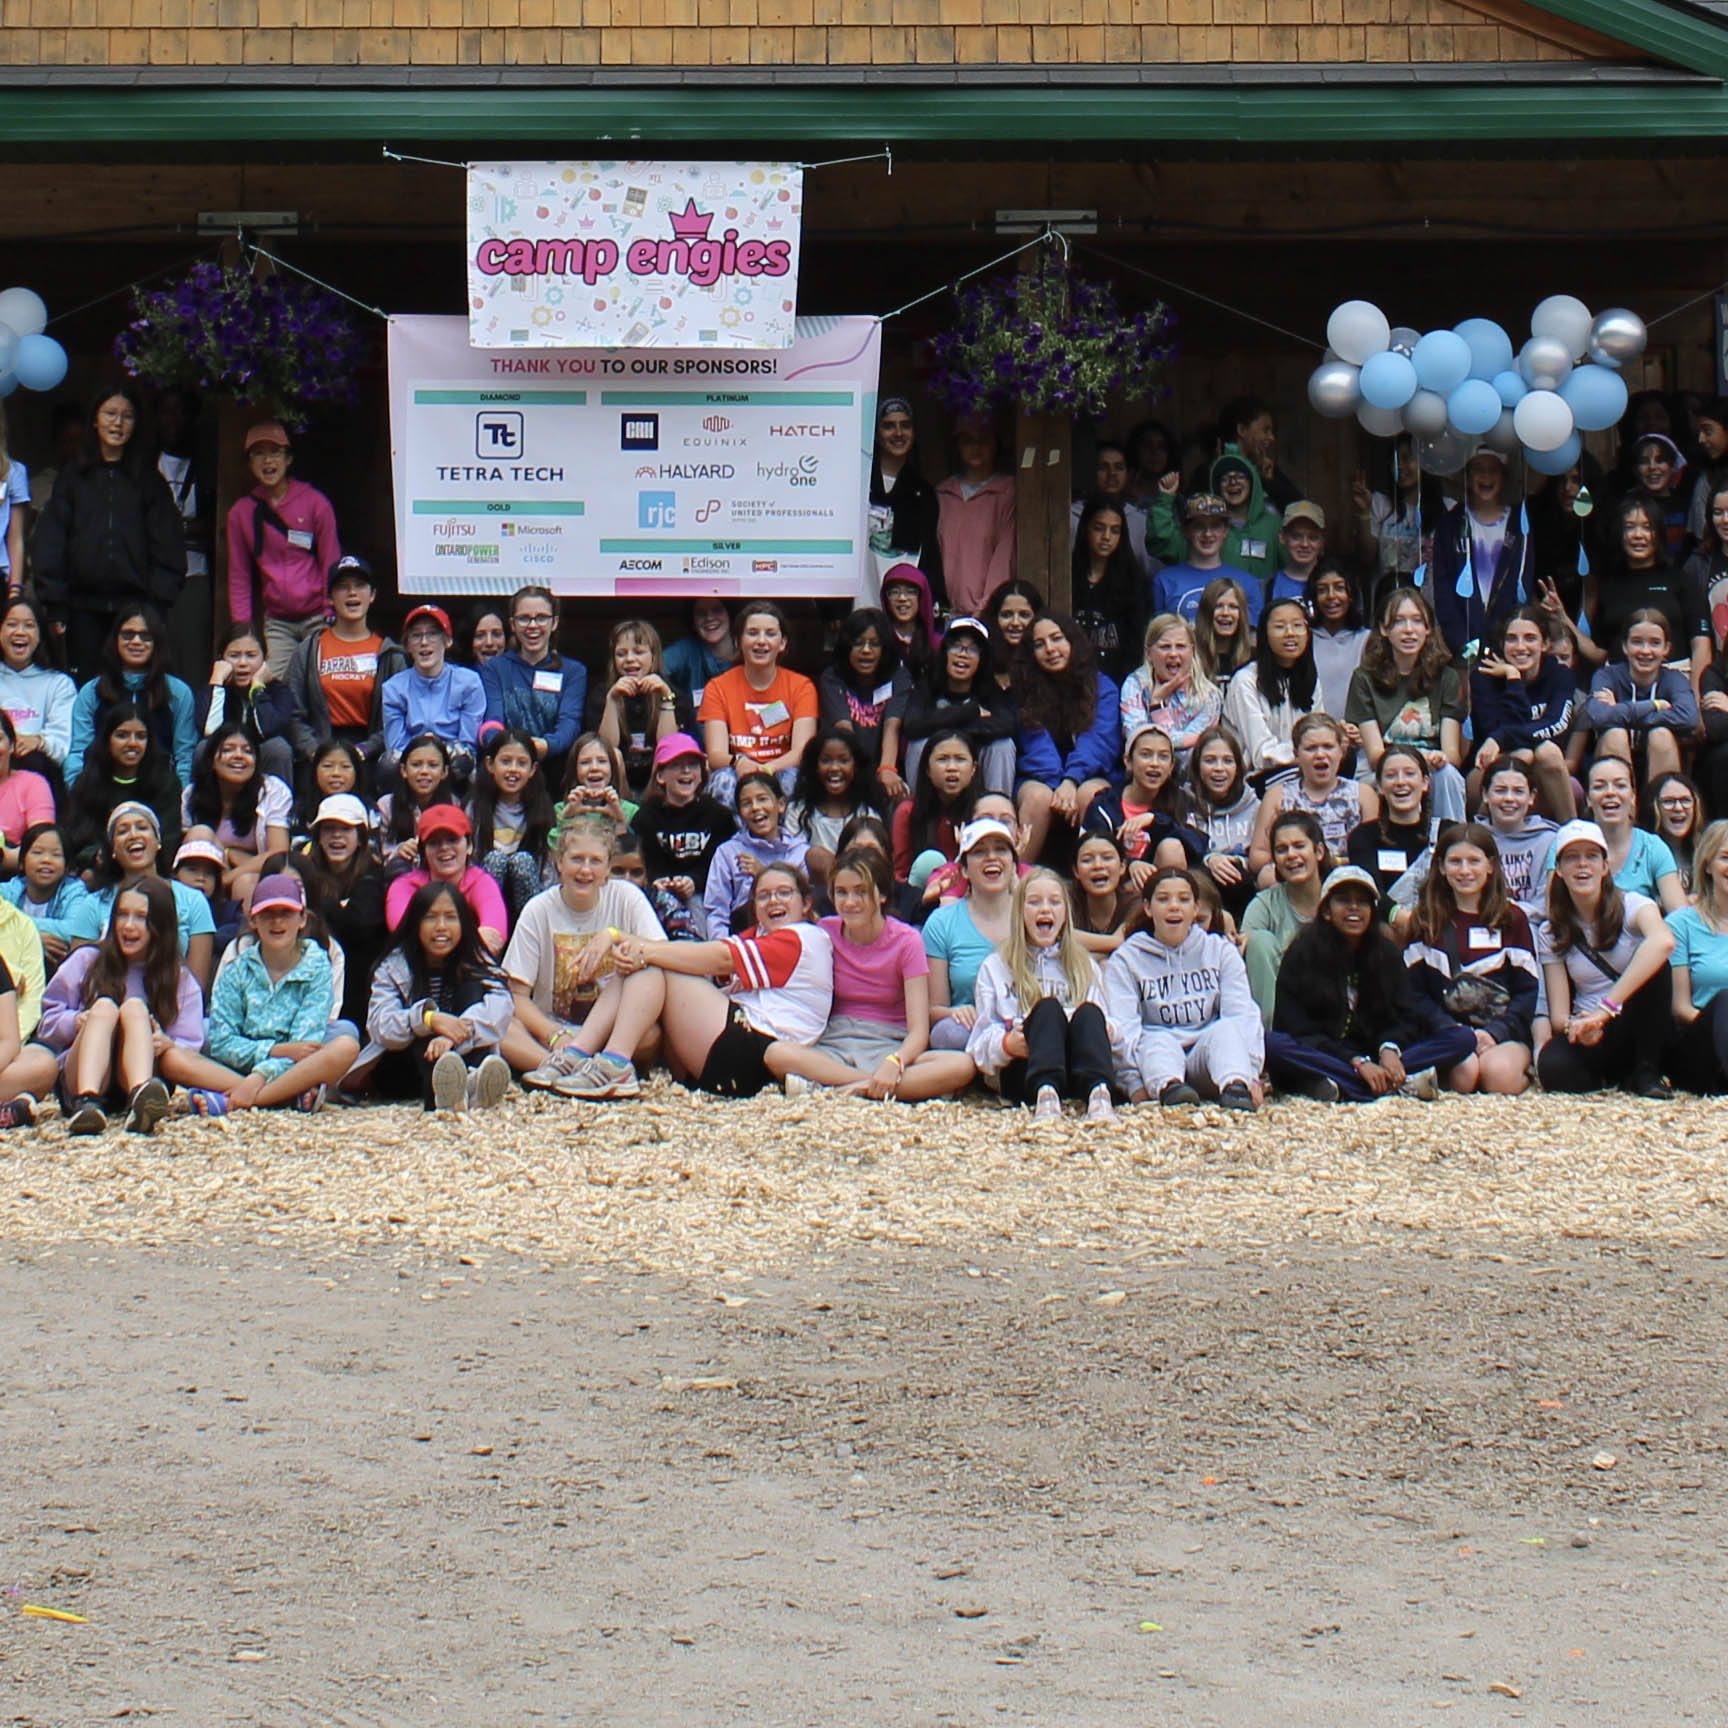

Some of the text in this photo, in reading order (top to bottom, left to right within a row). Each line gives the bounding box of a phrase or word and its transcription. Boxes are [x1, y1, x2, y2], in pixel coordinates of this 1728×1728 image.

[476, 228, 791, 286] camp engies
[491, 359, 777, 374] THANK YOU TO OUR SPONSORS!
[770, 425, 835, 437] HATCH
[683, 438, 747, 447] EQUINIX
[436, 467, 564, 481] TETRA TECH
[660, 464, 735, 479] HALYARD
[757, 462, 799, 480] hydro
[790, 475, 817, 487] one
[487, 503, 511, 512] GOLD
[731, 500, 768, 508] SOCIETY
[731, 509, 834, 517] UNITED PROFESSIONALS
[517, 524, 562, 535] Microsoft
[712, 542, 741, 551] SILVER
[619, 559, 662, 571] AECOM
[691, 556, 730, 570] Edison
[1159, 997, 1206, 1025] CITY
